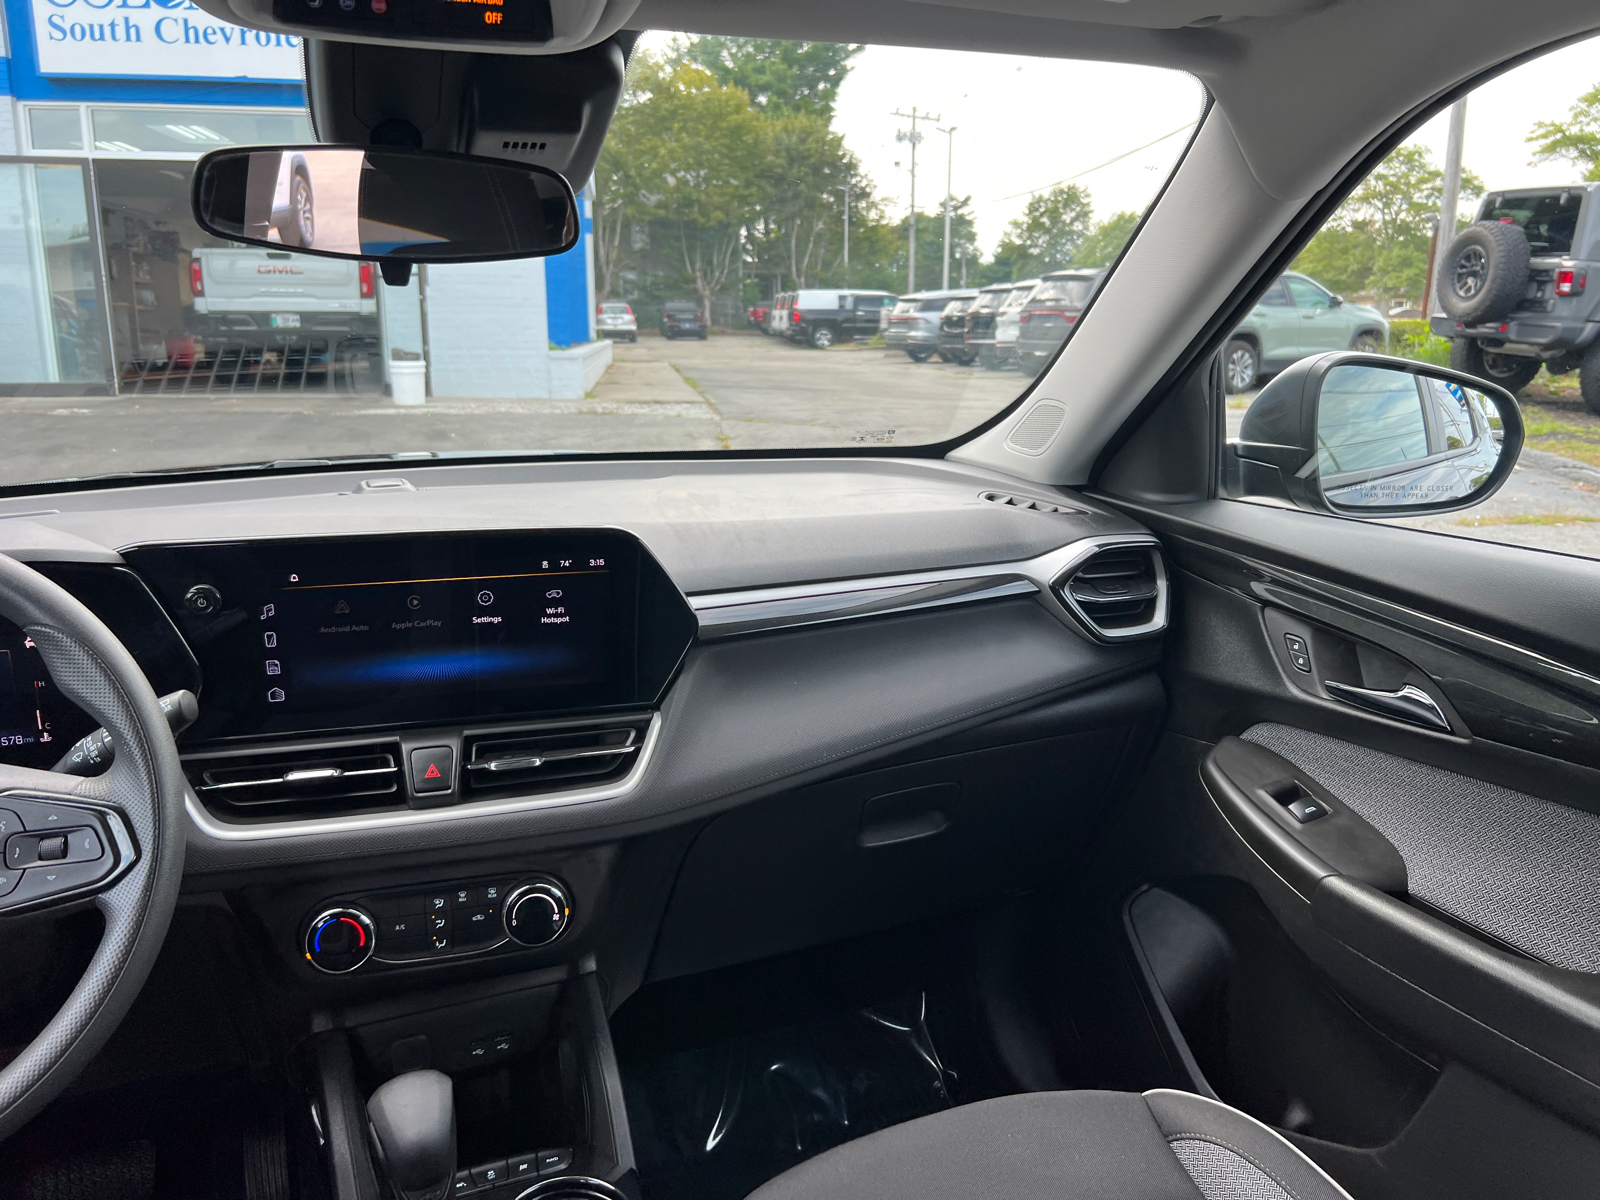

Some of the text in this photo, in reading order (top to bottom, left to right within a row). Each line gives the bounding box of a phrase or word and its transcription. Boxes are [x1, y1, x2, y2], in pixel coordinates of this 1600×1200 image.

[484, 11, 503, 25] OFF
[47, 13, 143, 43] South
[257, 264, 304, 275] GMC
[589, 559, 605, 567] 3:15
[391, 619, 442, 630] Apple CarPlay
[472, 614, 502, 625] Settings
[541, 616, 570, 624] Hotspot
[320, 625, 350, 633] Android
